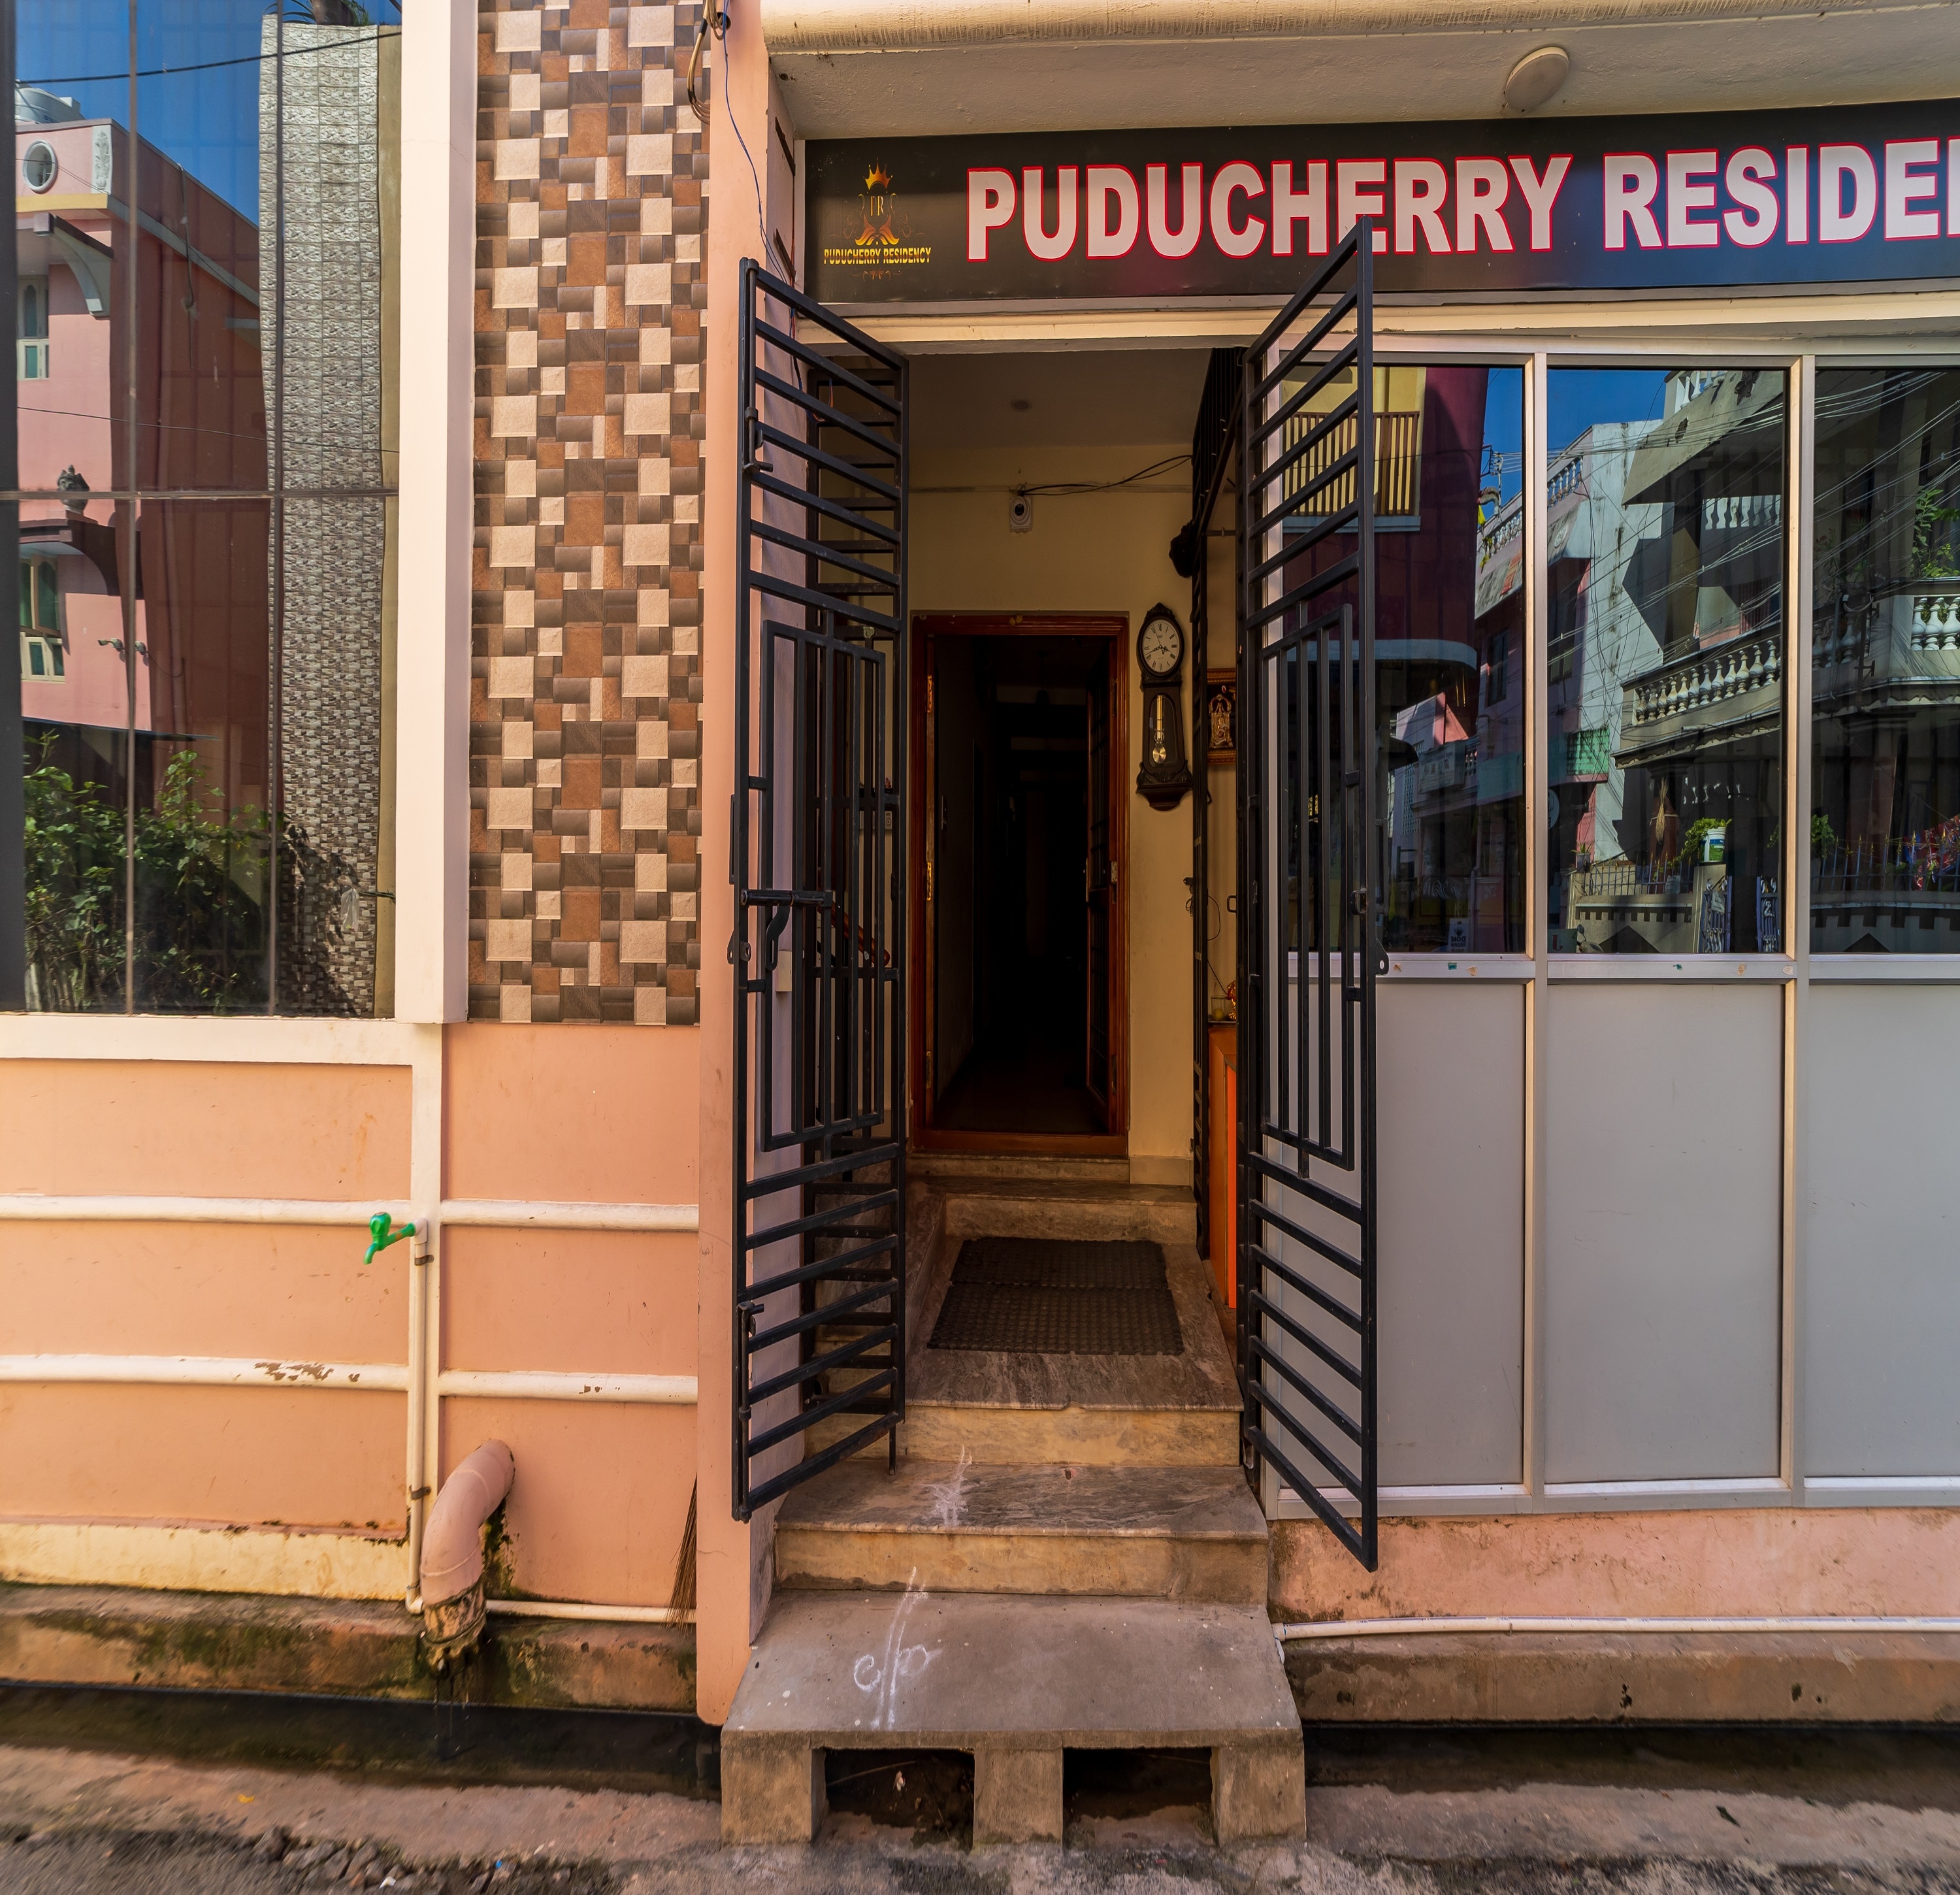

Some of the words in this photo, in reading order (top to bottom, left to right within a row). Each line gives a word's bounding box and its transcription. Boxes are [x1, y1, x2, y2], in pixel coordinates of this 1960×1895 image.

[967, 154, 1574, 262] PUDUCHERRY
[1603, 136, 1960, 252] RESIDE
[823, 248, 881, 264] PUDUCHERRY
[883, 247, 932, 263] RESIDENCY
